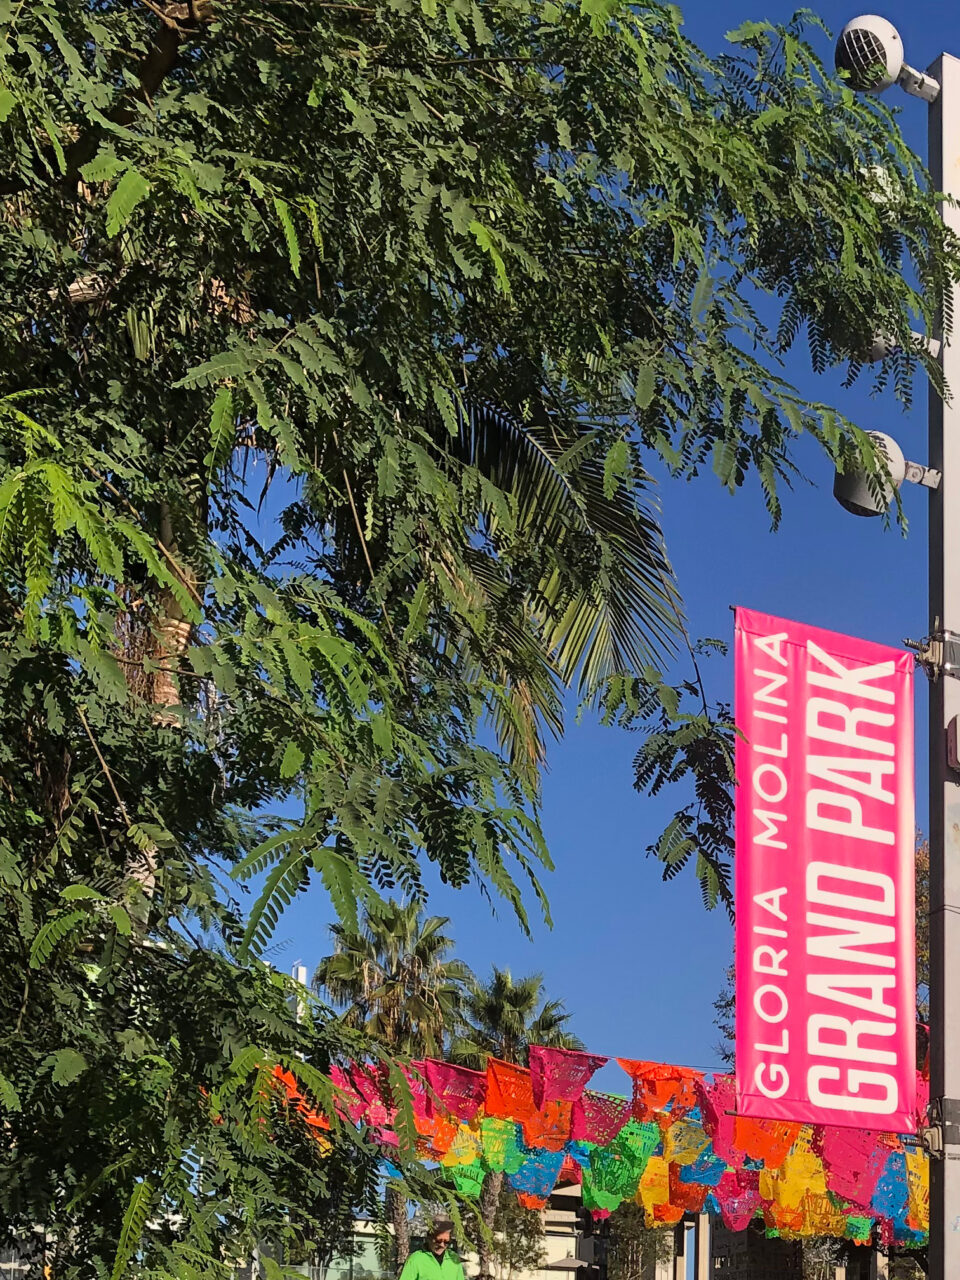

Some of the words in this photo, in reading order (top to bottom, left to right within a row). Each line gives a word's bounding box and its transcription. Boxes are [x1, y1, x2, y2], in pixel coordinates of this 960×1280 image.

[752, 631, 790, 851] MOLINA
[805, 640, 896, 846] PARK
[752, 886, 790, 1100] GLORIA
[806, 861, 900, 1115] GRAND
